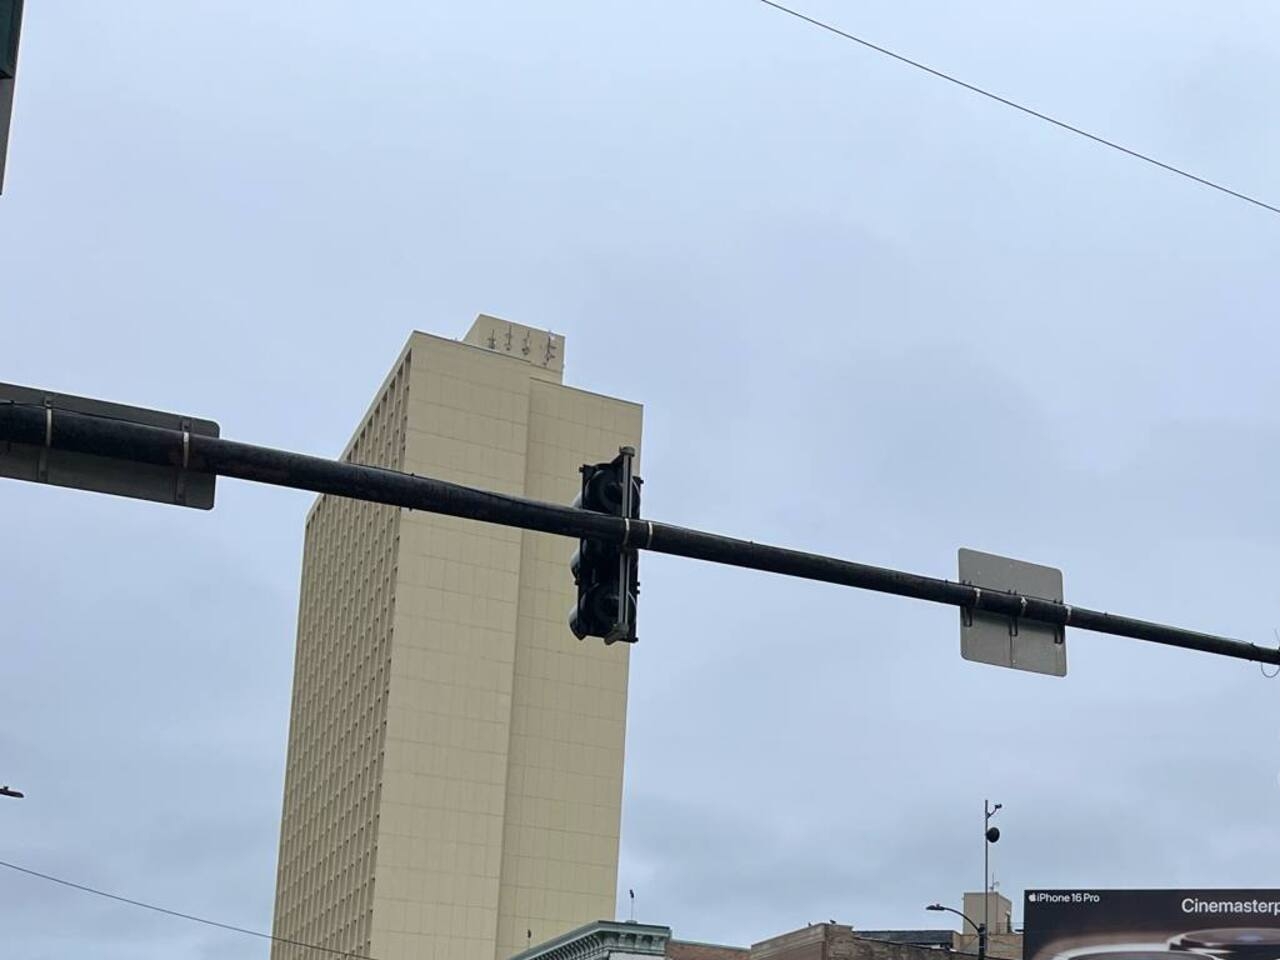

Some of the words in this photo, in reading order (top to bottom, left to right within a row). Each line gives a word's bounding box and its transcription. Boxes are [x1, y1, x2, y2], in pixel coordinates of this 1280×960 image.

[1036, 893, 1071, 902] iPhone
[1071, 893, 1082, 902] 16
[1083, 893, 1100, 902] Pro
